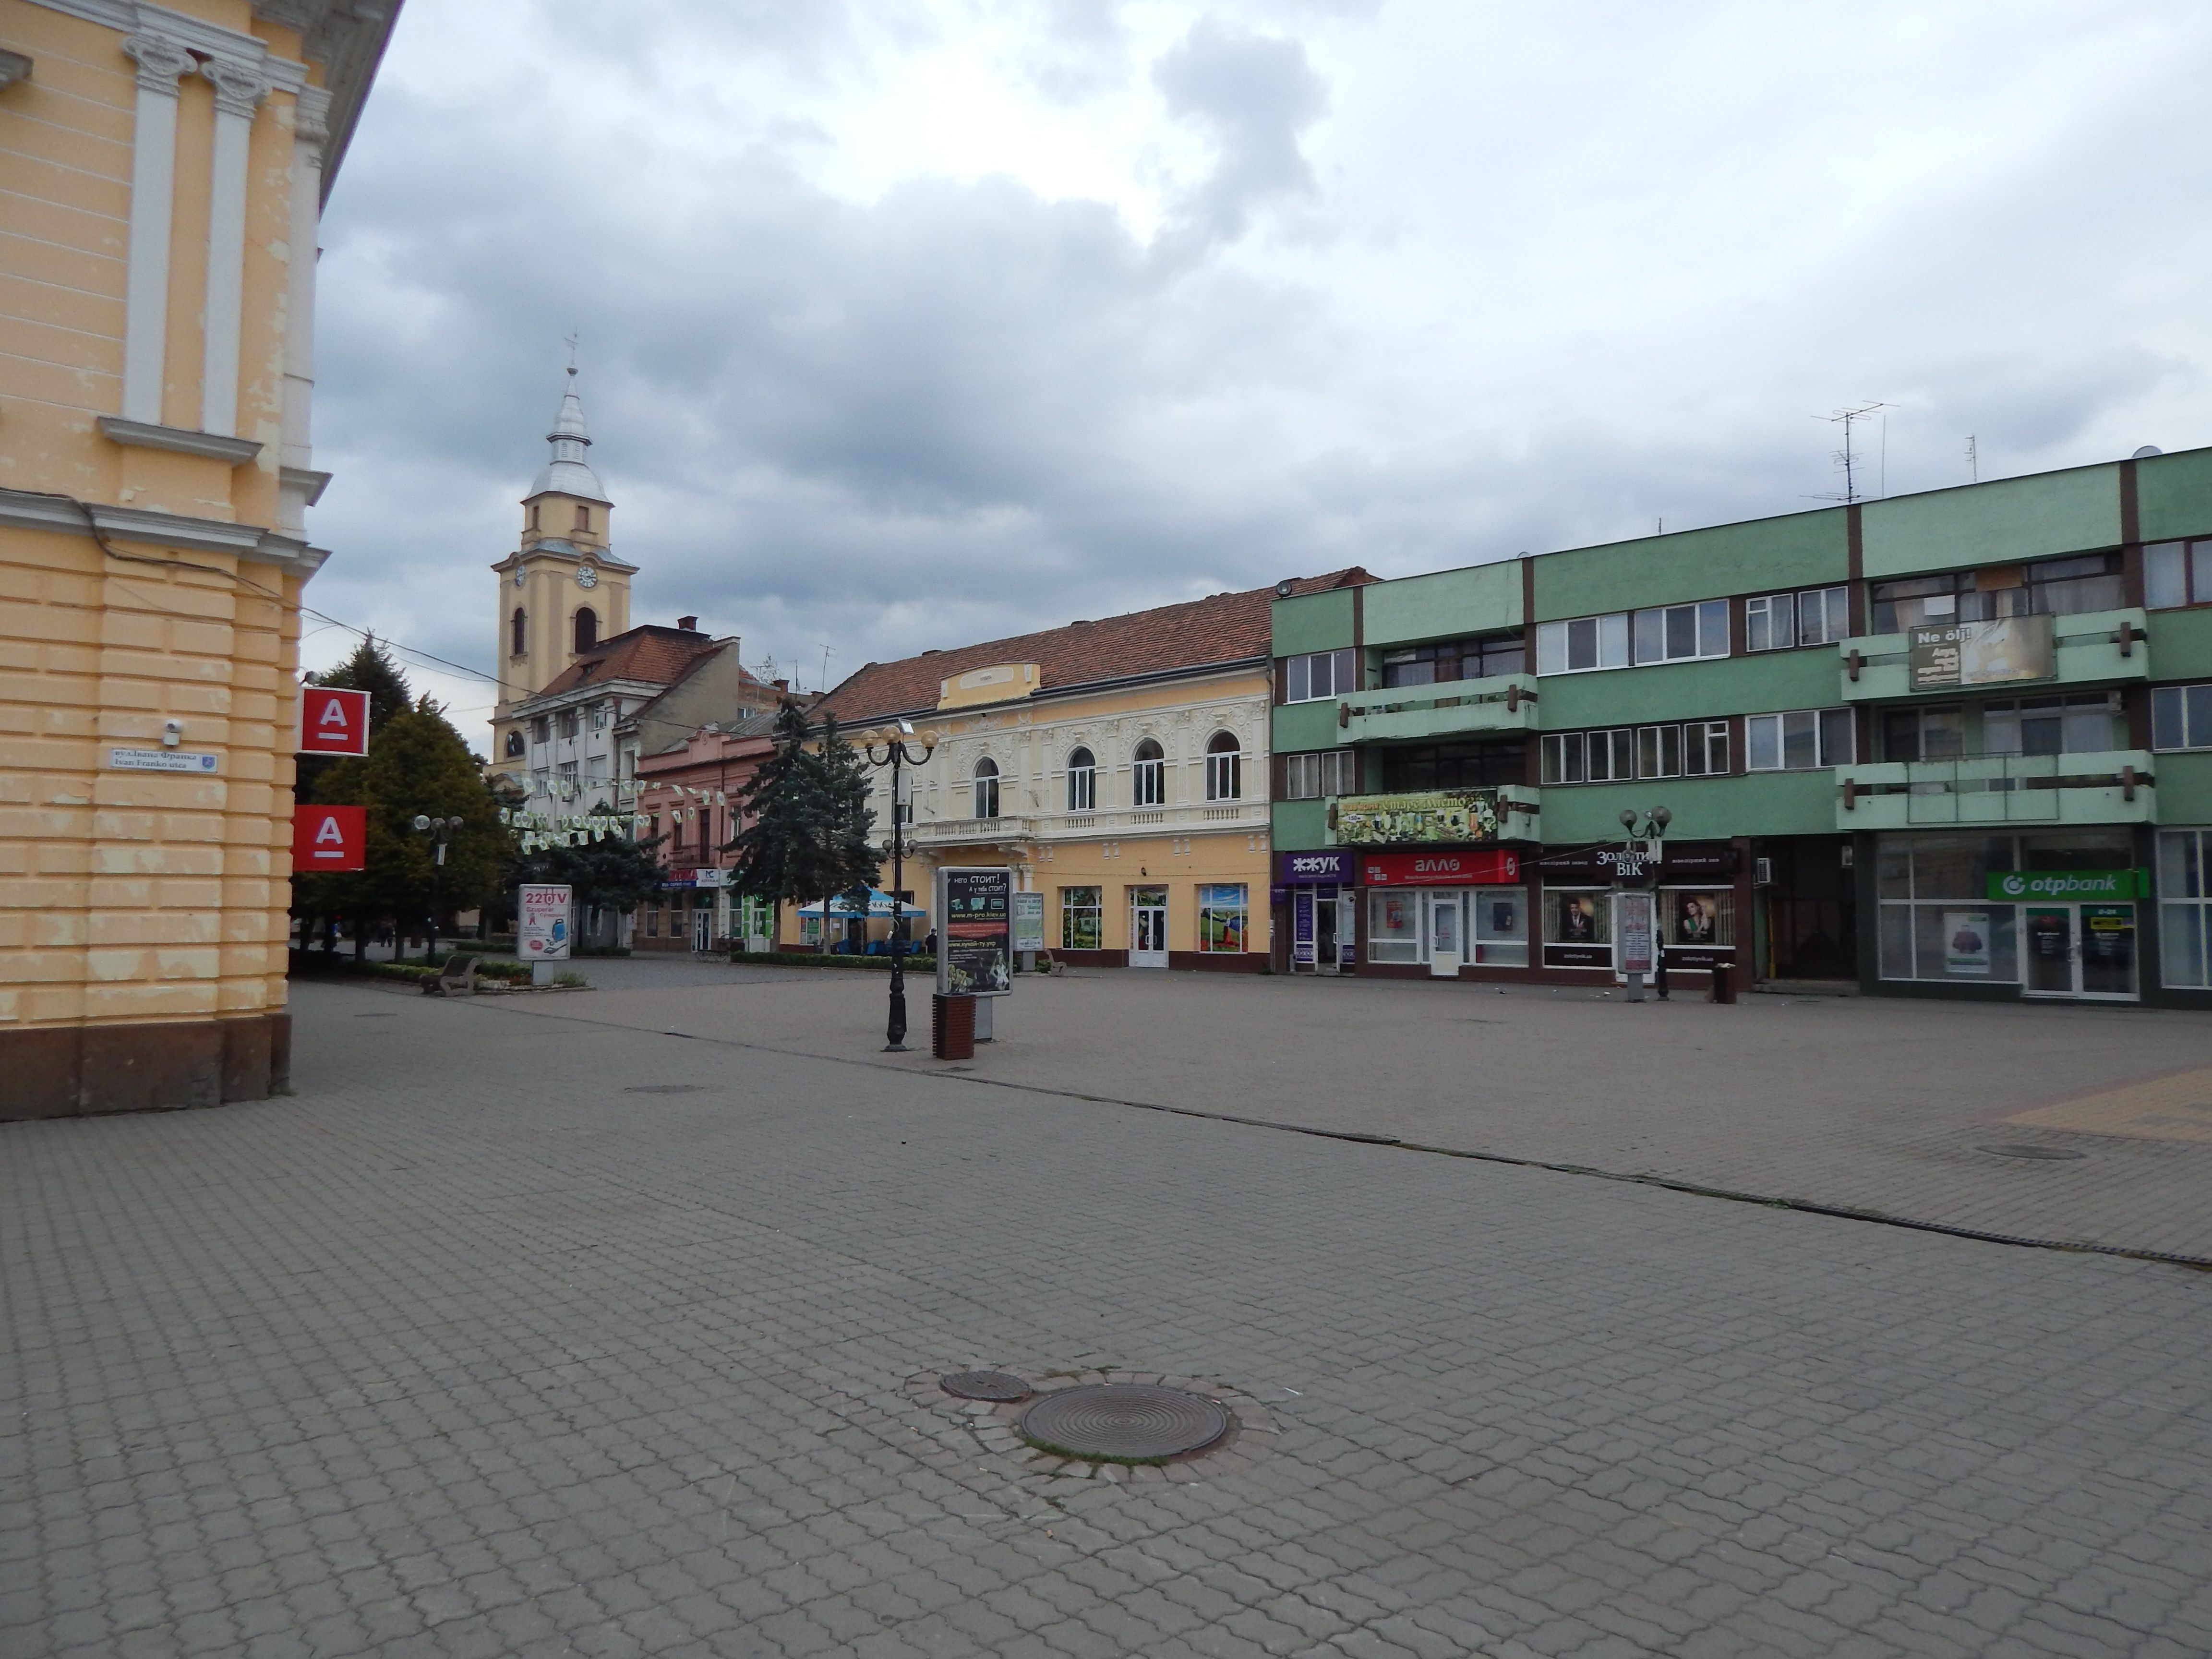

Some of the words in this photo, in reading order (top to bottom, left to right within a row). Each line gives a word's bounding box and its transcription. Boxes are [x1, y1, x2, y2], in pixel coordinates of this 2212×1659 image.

[1918, 632, 1940, 644] Ne
[1945, 628, 1971, 643] ölj!
[320, 698, 348, 727] A
[315, 816, 344, 844] A
[1597, 851, 1662, 865] Золти
[1616, 863, 1643, 876] ВІК
